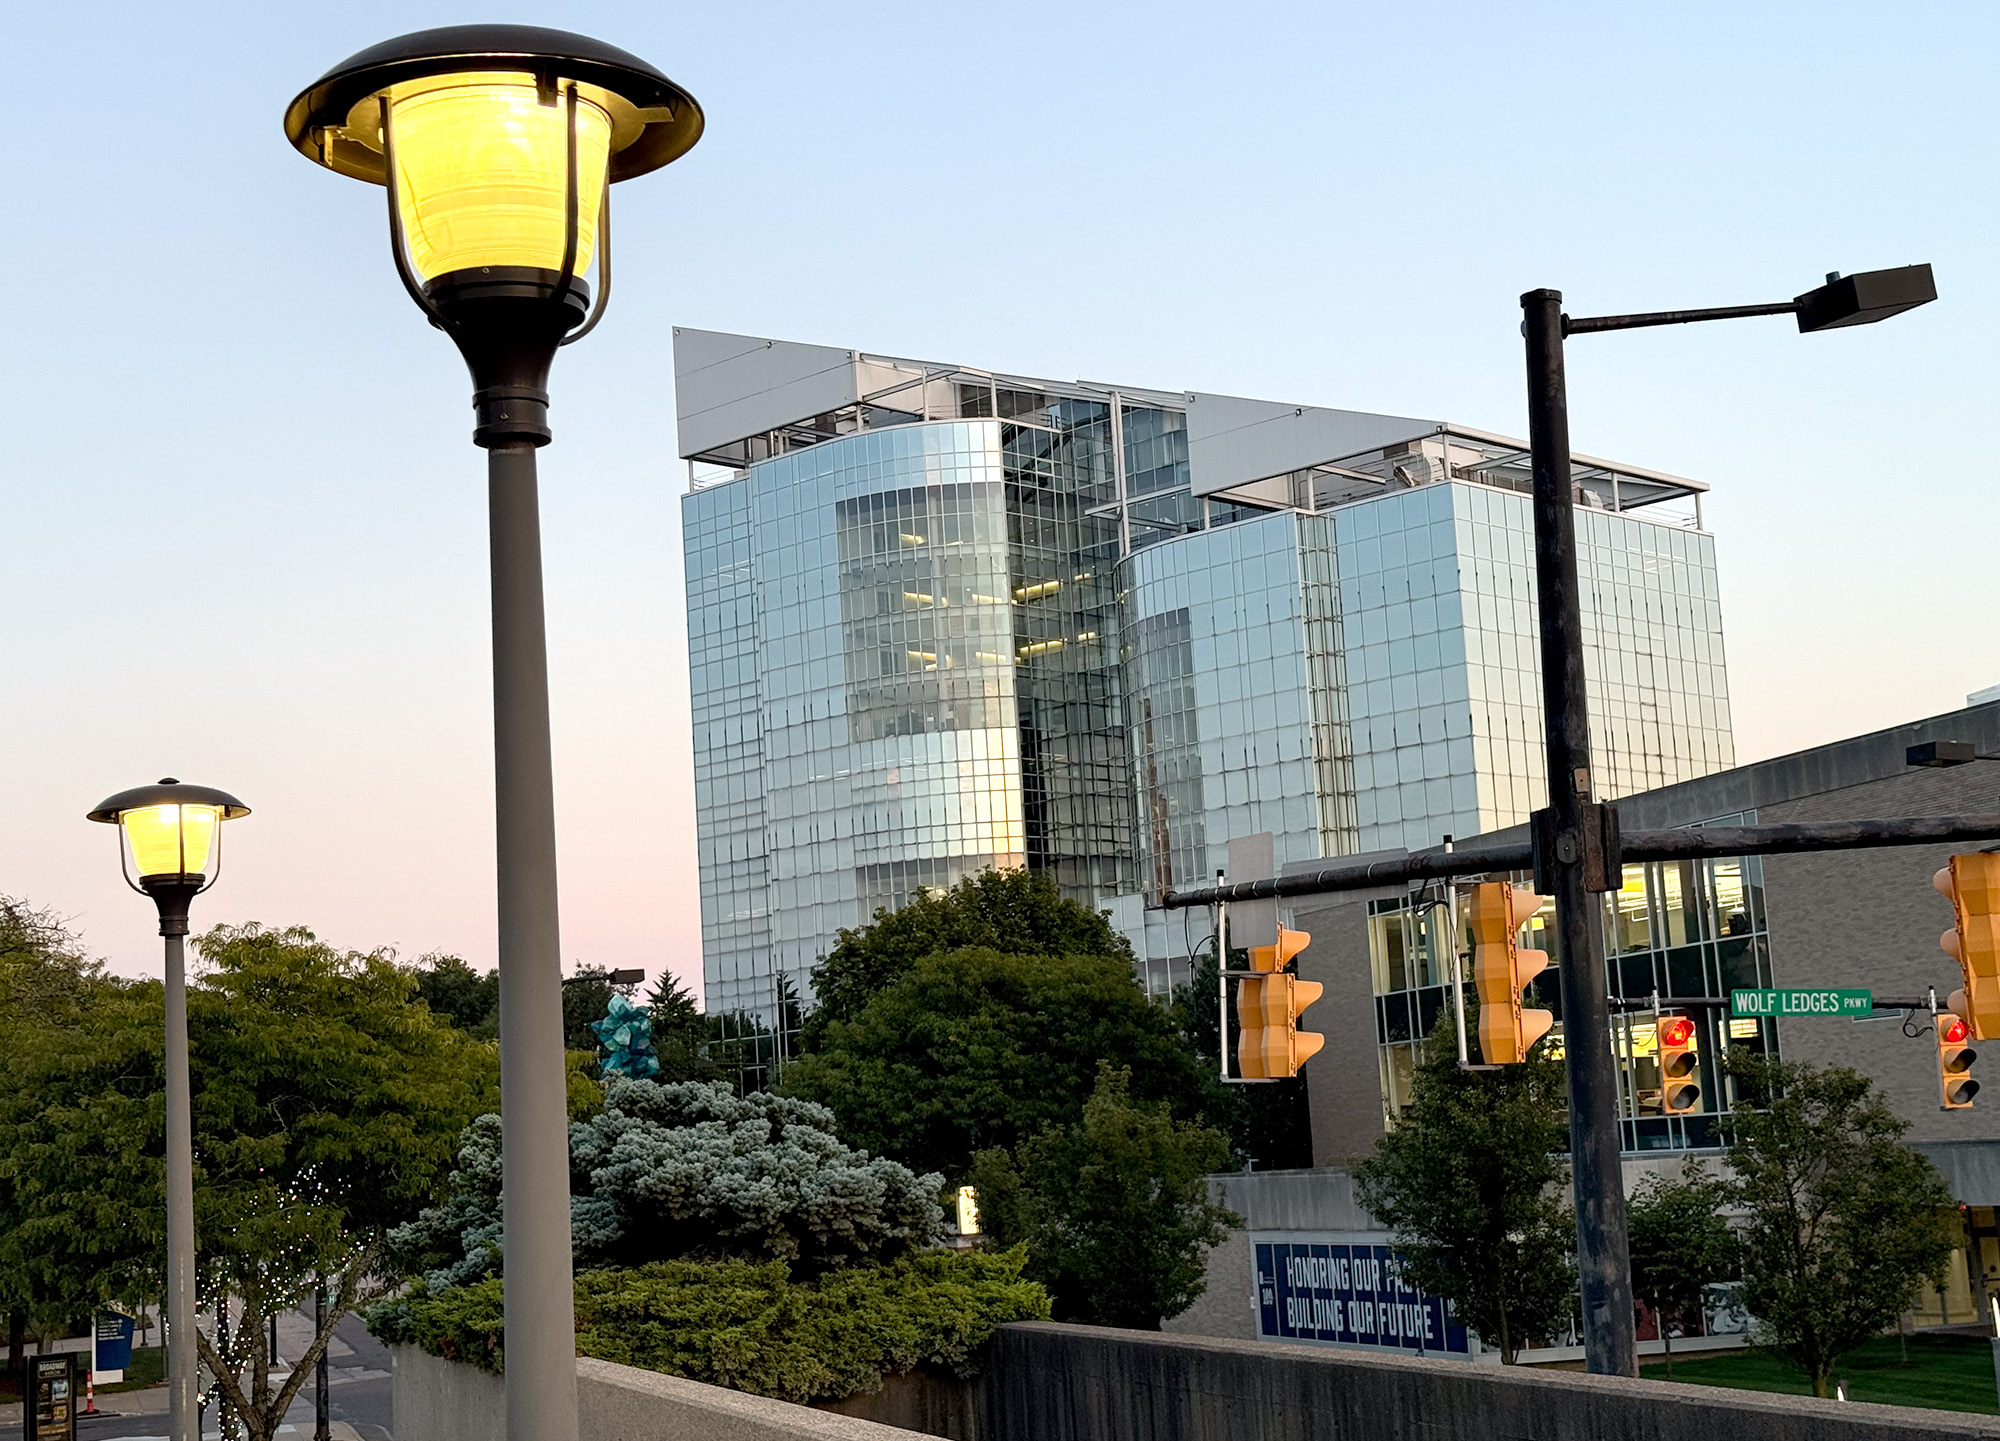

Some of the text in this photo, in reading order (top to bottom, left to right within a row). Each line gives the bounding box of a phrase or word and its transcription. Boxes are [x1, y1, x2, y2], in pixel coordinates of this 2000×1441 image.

[1735, 992, 1867, 1013] WOLF LEDGES PKWY
[1286, 1256, 1350, 1291] HONORING
[1353, 1258, 1381, 1292] OUR
[1286, 1297, 1344, 1332] BUILDING
[1348, 1301, 1375, 1335] OUR
[1379, 1302, 1434, 1339] FUTURE
